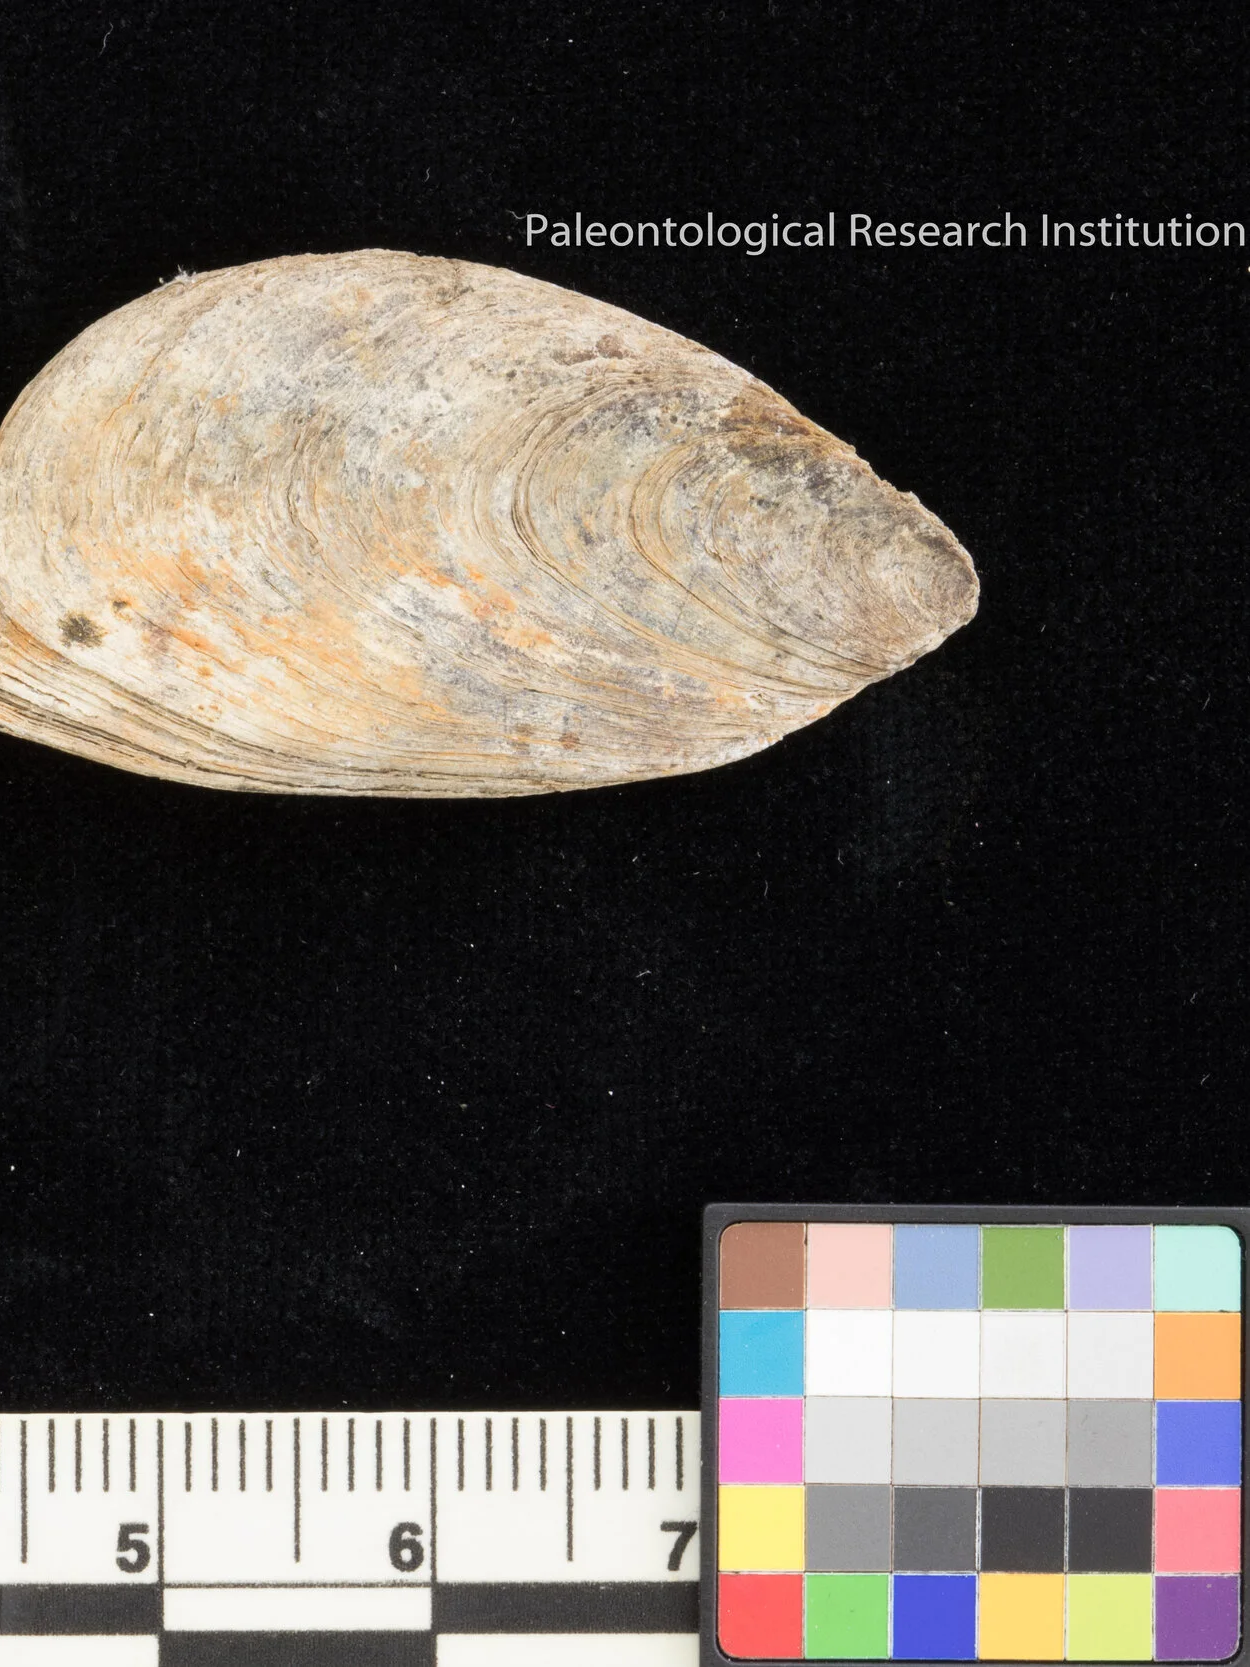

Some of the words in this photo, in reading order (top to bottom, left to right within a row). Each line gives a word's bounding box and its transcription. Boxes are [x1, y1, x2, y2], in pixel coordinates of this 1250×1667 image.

[117, 1524, 150, 1572] 5
[389, 1523, 423, 1571] 6
[661, 1521, 698, 1571] 7
